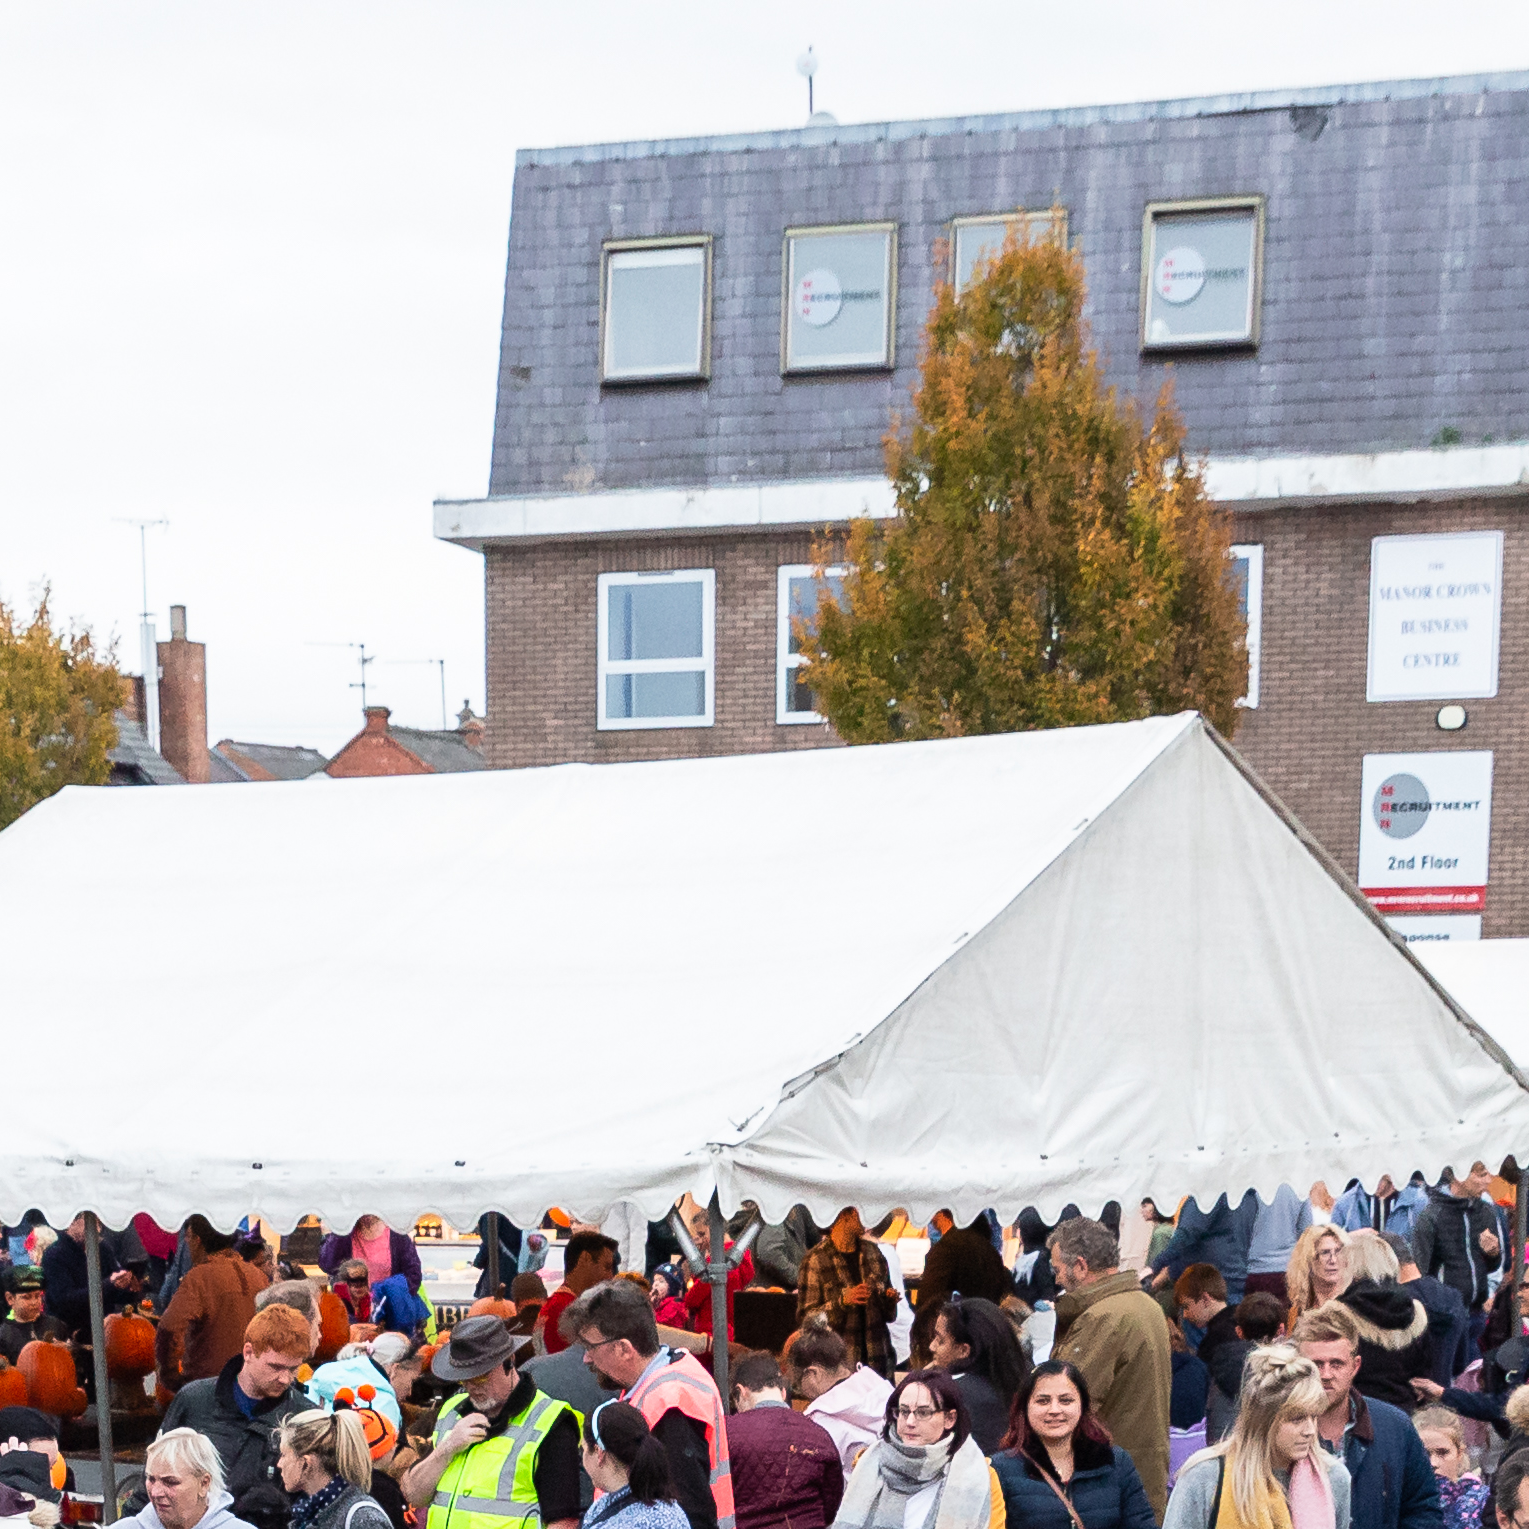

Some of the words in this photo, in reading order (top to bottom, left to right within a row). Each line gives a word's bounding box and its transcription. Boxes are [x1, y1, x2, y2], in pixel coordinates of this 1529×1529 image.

[1379, 585, 1433, 601] MANOR
[1436, 582, 1492, 599] CROWN
[1401, 618, 1469, 635] BUSINESS
[1402, 653, 1461, 669] CENTRE
[1387, 855, 1416, 871] 2nd
[1421, 855, 1460, 870] Floor
